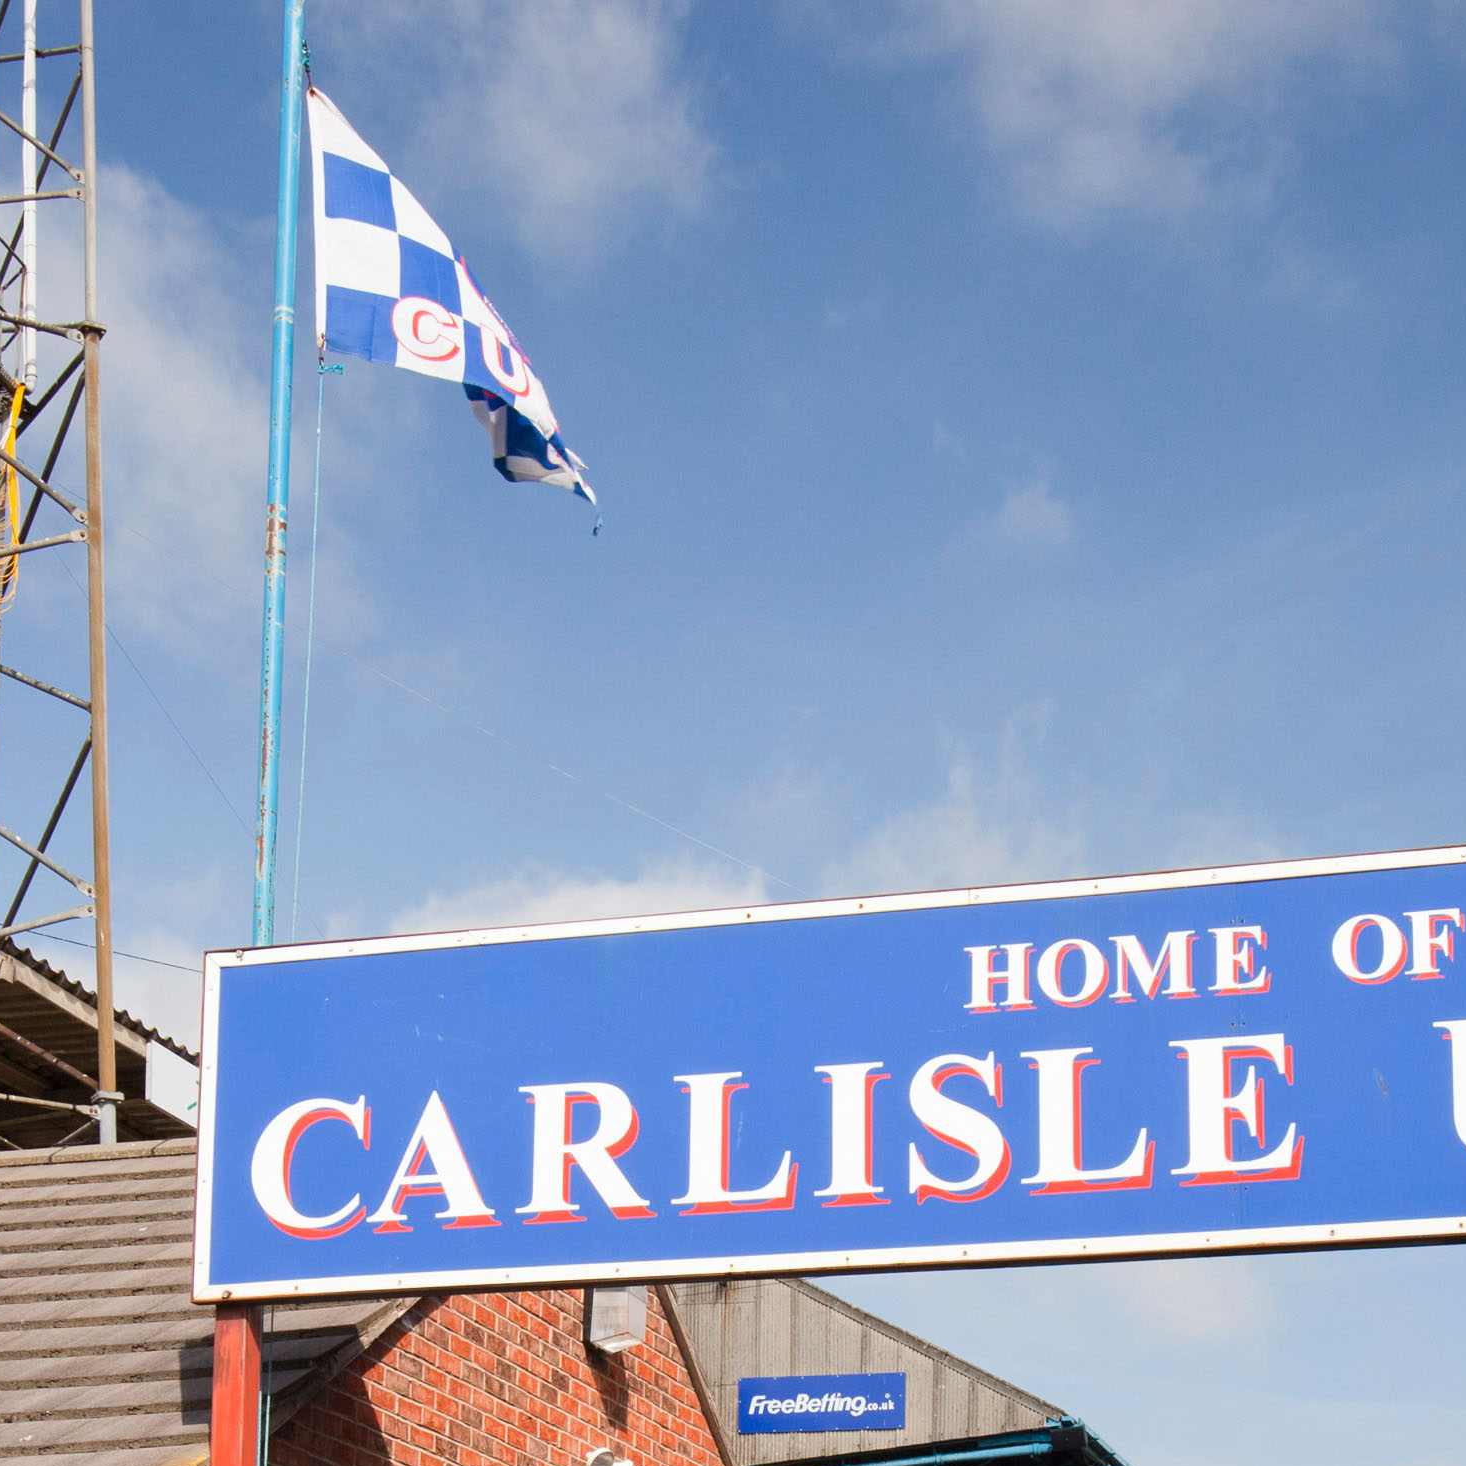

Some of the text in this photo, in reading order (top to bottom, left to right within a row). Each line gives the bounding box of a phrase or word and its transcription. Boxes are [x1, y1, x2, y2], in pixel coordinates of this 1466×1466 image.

[963, 907, 1466, 1015] HOME OF
[250, 1032, 1304, 1240] CARLISLE
[748, 1393, 895, 1417] FreeBetting.co.uk
